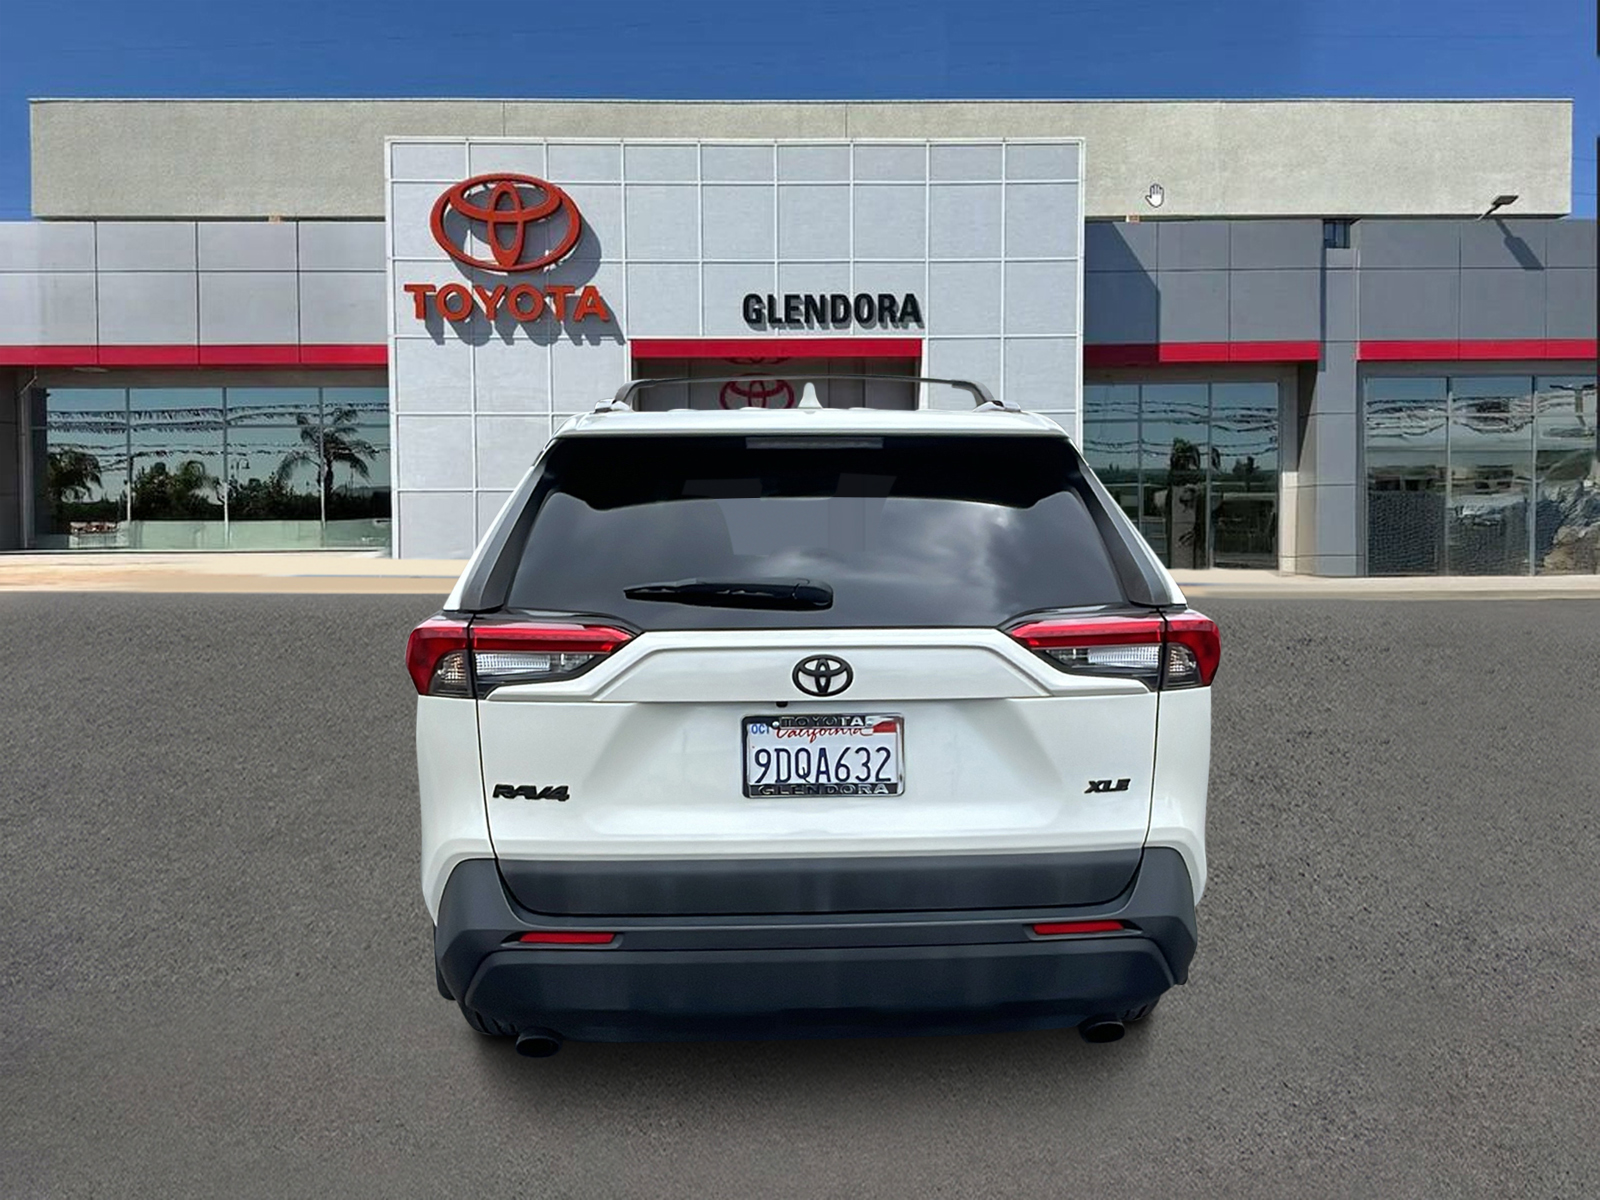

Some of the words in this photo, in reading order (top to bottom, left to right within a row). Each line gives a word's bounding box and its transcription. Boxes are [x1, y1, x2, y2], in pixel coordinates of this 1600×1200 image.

[404, 284, 610, 323] TOYOTA
[742, 293, 923, 326] GLENDORA
[780, 716, 864, 727] TOYOTA
[754, 746, 892, 784] 9DQA632
[492, 783, 570, 802] RAV4
[758, 783, 889, 795] GLENDORA
[1084, 778, 1131, 794] XLE
